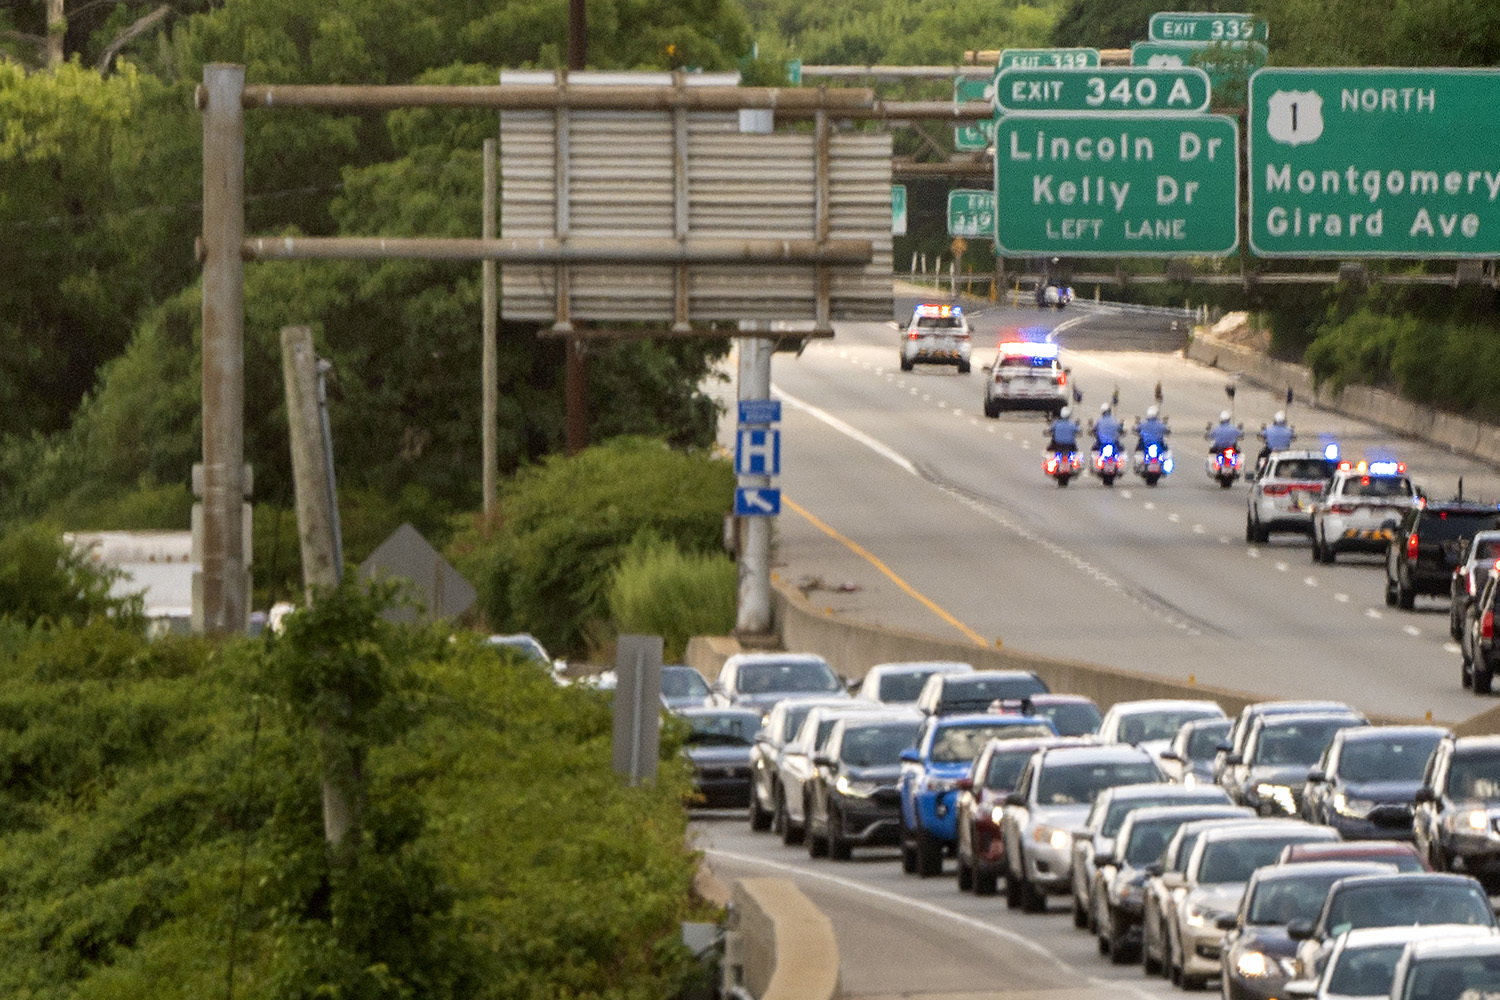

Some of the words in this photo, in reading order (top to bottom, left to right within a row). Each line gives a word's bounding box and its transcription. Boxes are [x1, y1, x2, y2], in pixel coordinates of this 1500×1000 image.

[1163, 21, 1197, 37] EXIT
[1012, 81, 1064, 102] EXIT
[1340, 88, 1436, 112] NORTH
[1010, 130, 1154, 162] Lincoln
[1179, 131, 1223, 162] Dr
[1032, 174, 1131, 213] Kelly
[1157, 175, 1199, 206] Dr
[1046, 218, 1104, 241] LEFT
[1124, 218, 1187, 241] LANE
[1265, 206, 1385, 238] Girard
[1409, 207, 1481, 238] Ave
[740, 431, 775, 473] H
